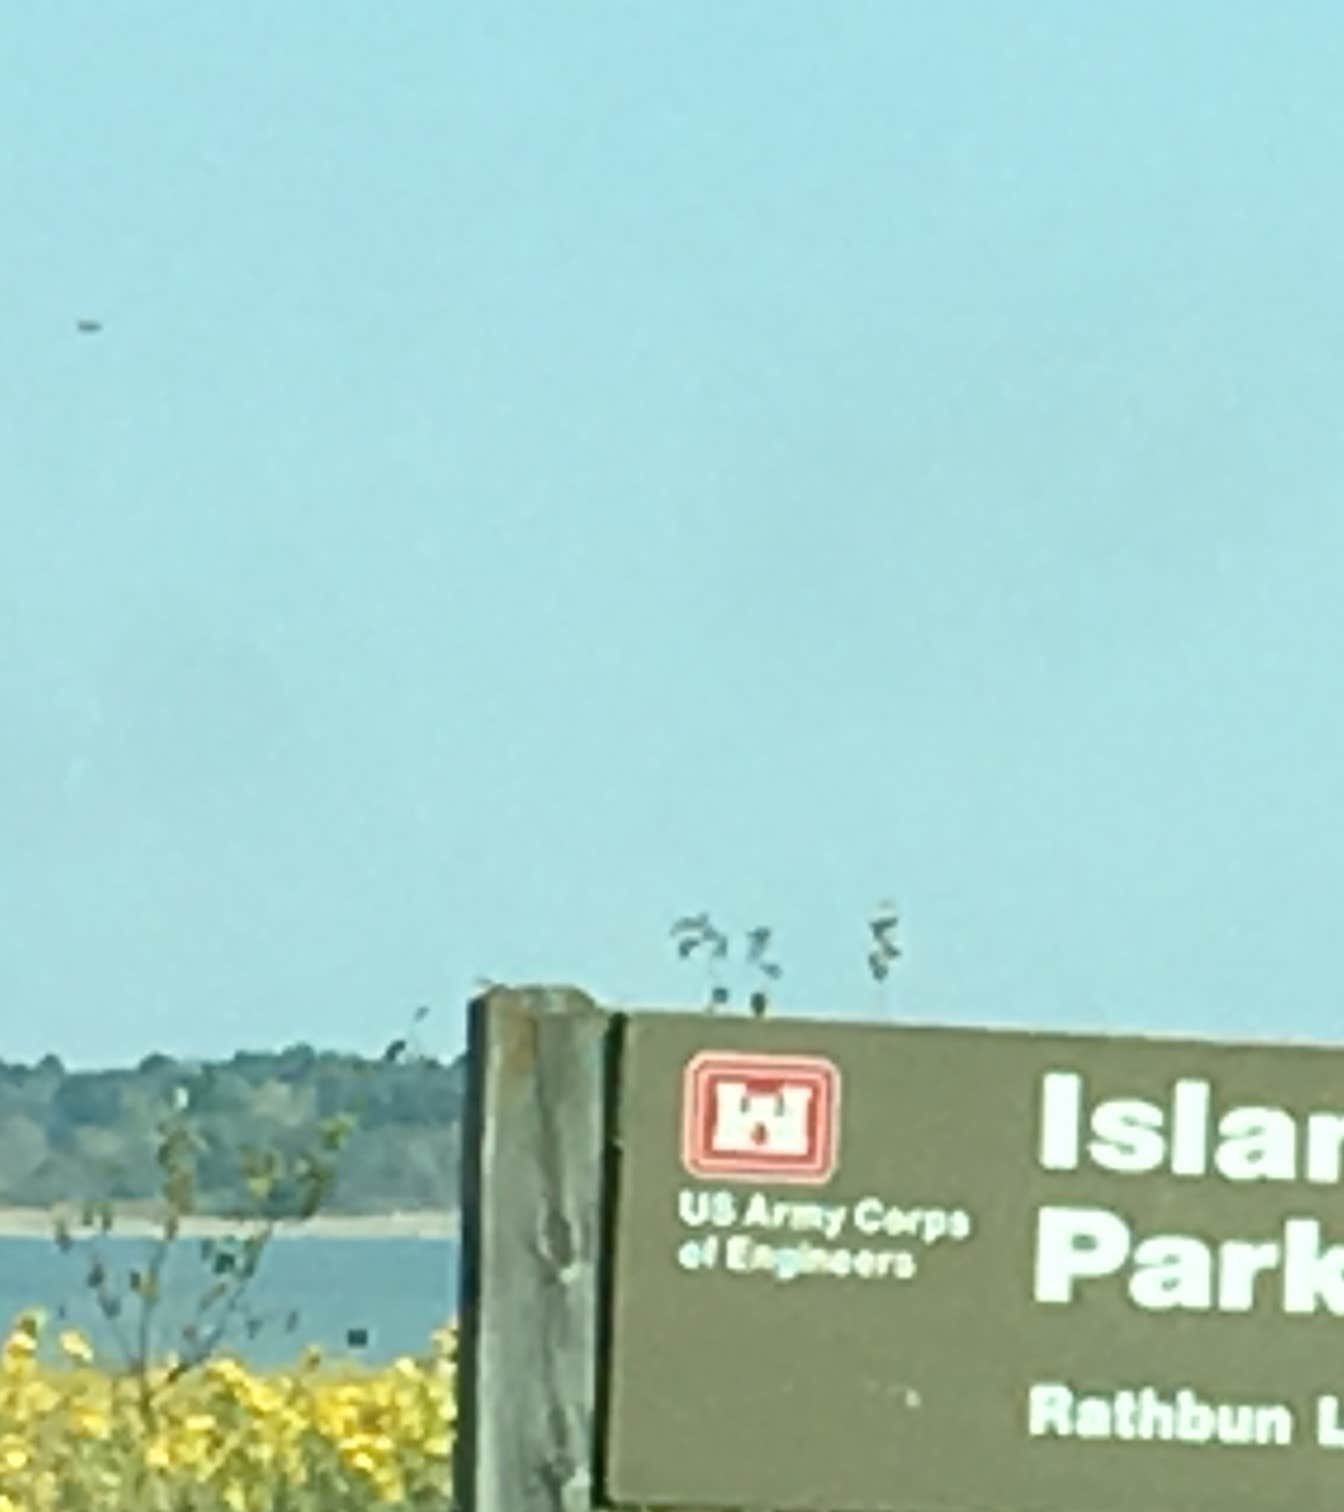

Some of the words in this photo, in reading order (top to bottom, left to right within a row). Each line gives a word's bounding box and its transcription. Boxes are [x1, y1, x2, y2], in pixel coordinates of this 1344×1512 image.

[677, 1188, 736, 1227] US
[742, 1192, 846, 1239] Army
[853, 1197, 972, 1243] Corps
[677, 1235, 718, 1271] of
[725, 1235, 918, 1281] Engineers
[1027, 1382, 1293, 1446] Rathbun
